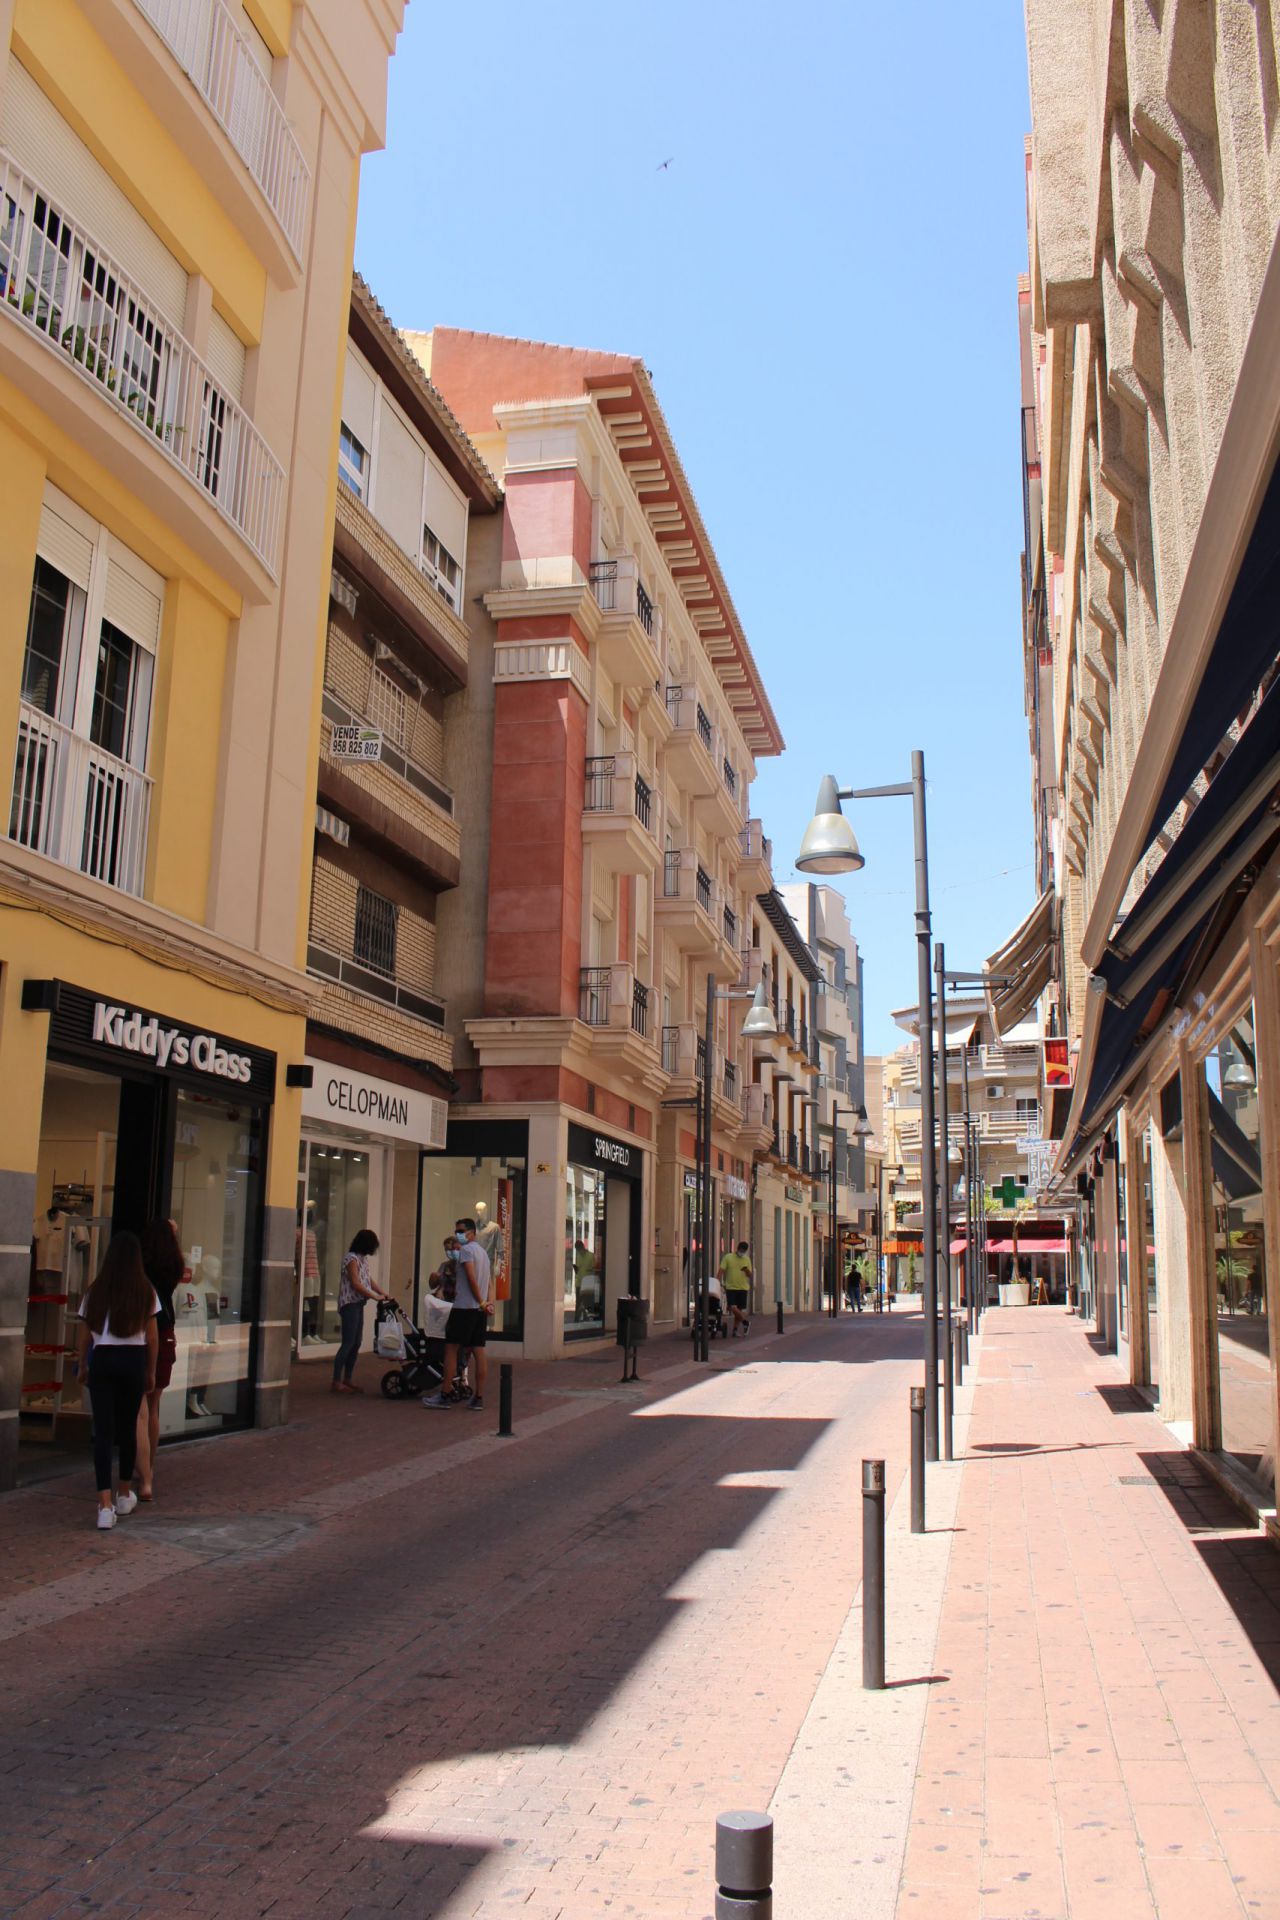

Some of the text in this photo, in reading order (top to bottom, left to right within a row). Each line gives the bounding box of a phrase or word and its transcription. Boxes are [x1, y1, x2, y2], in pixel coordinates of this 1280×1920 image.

[333, 727, 359, 739] VENDE
[333, 740, 378, 755] 958 825 802
[92, 1002, 252, 1083] Kiddy's Class
[327, 1079, 409, 1126] CELOPMAN
[595, 1137, 630, 1166] SPRINGFIELD
